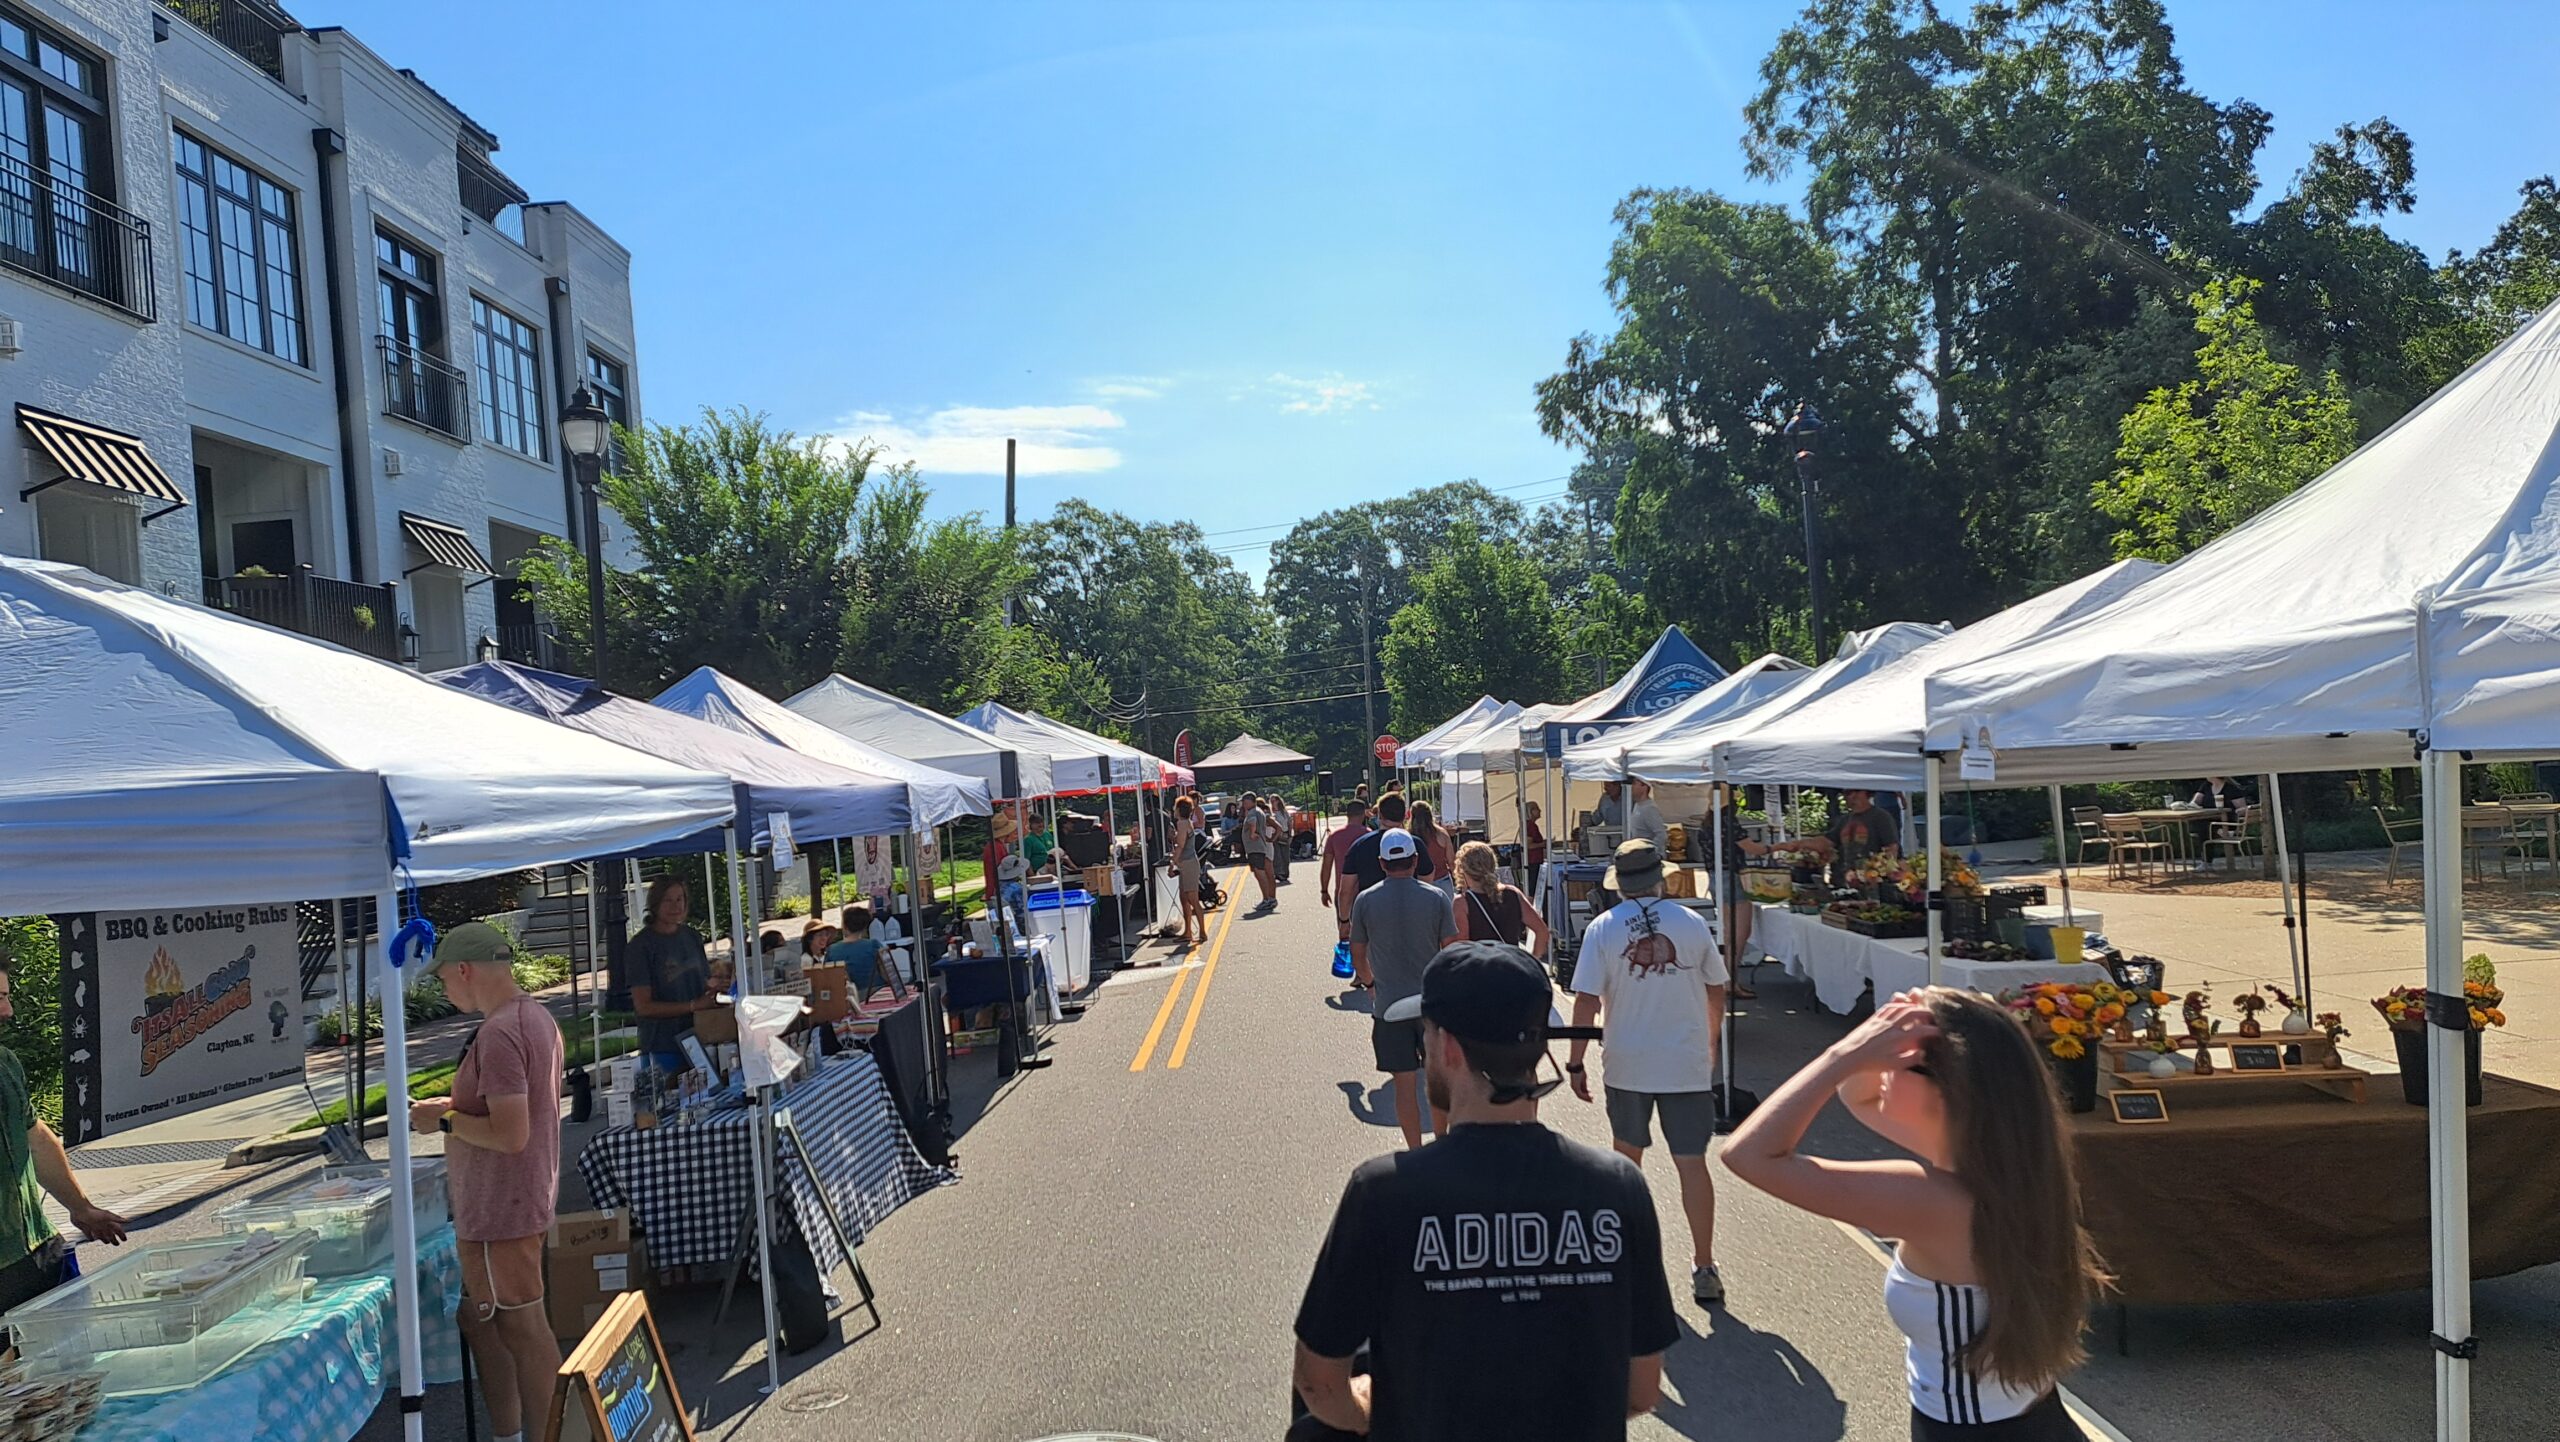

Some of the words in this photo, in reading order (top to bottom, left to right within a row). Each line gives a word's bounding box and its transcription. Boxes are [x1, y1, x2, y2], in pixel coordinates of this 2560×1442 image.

[1650, 674, 1677, 692] TRUST
[1376, 743, 1397, 753] STOP
[105, 917, 149, 940] BBQ
[152, 915, 168, 936] &
[172, 910, 245, 933] Cooking
[248, 906, 288, 926] Rubs
[140, 977, 252, 1077] SEASONING
[206, 1038, 242, 1053] Clayton,
[243, 1033, 255, 1044] NC
[104, 1108, 140, 1123] Veteran
[141, 1099, 169, 1114] Owned
[175, 1094, 187, 1105] All
[188, 1086, 217, 1101] Natural
[223, 1080, 247, 1092] Gluten
[248, 1076, 264, 1086] Free
[1413, 1208, 1623, 1272] ADIDAS
[1424, 1280, 1447, 1292] THE
[1447, 1277, 1483, 1291] BRAND
[1485, 1276, 1513, 1289] WITH
[1513, 1275, 1537, 1288] THE
[1538, 1274, 1574, 1286] THREE
[1576, 1272, 1613, 1285] STRIPES
